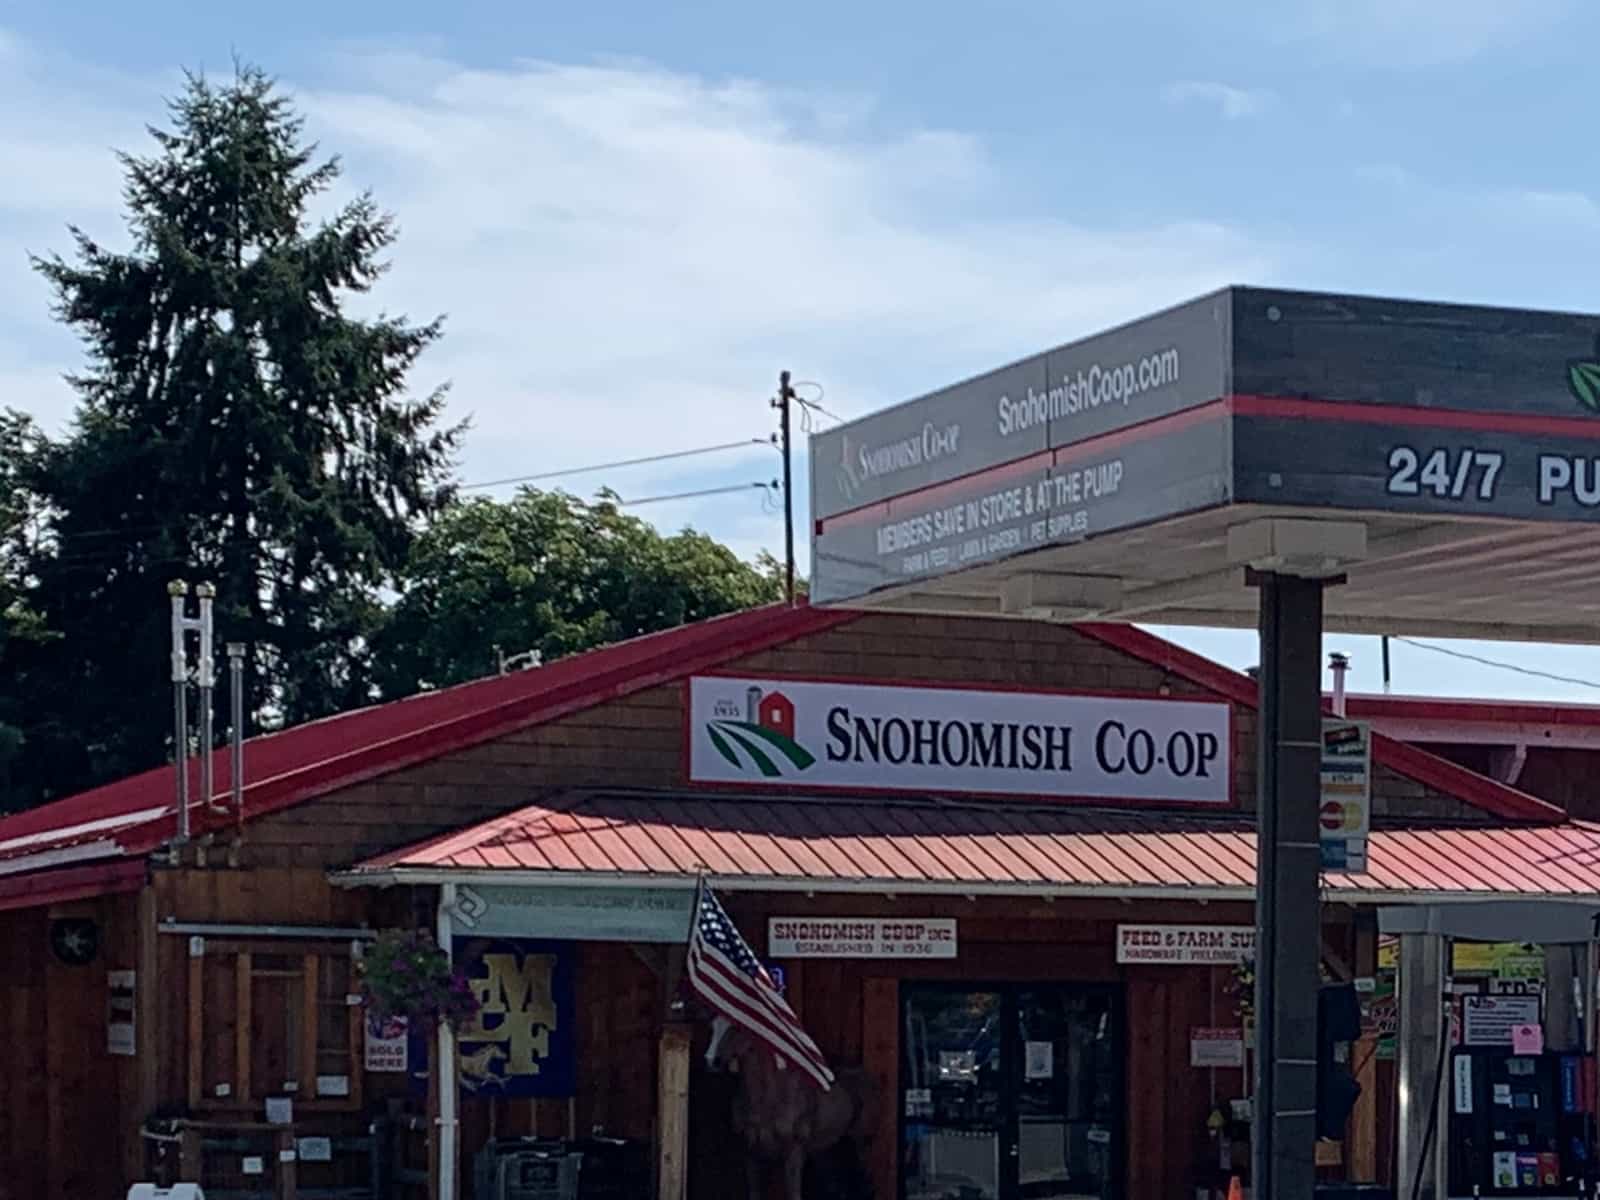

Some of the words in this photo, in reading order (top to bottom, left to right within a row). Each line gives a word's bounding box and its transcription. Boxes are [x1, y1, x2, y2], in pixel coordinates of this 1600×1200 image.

[999, 348, 1179, 435] SnohomishCoop.com
[1387, 447, 1504, 500] 24/7
[877, 510, 935, 555] MEMBERS
[934, 502, 965, 539] SAVE
[966, 499, 980, 531] IN
[981, 486, 1021, 526] STORE
[1024, 485, 1033, 513] &
[1036, 479, 1053, 511] AT
[1055, 471, 1081, 505] THE
[1083, 460, 1123, 500] PUMP
[825, 706, 1073, 772] SNOHOMISH
[774, 923, 875, 941] SNOHOMISH
[795, 942, 873, 954] ESTABLISHED
[881, 943, 894, 954] IN
[1122, 930, 1161, 946] FEED
[1177, 931, 1224, 947] FARM
